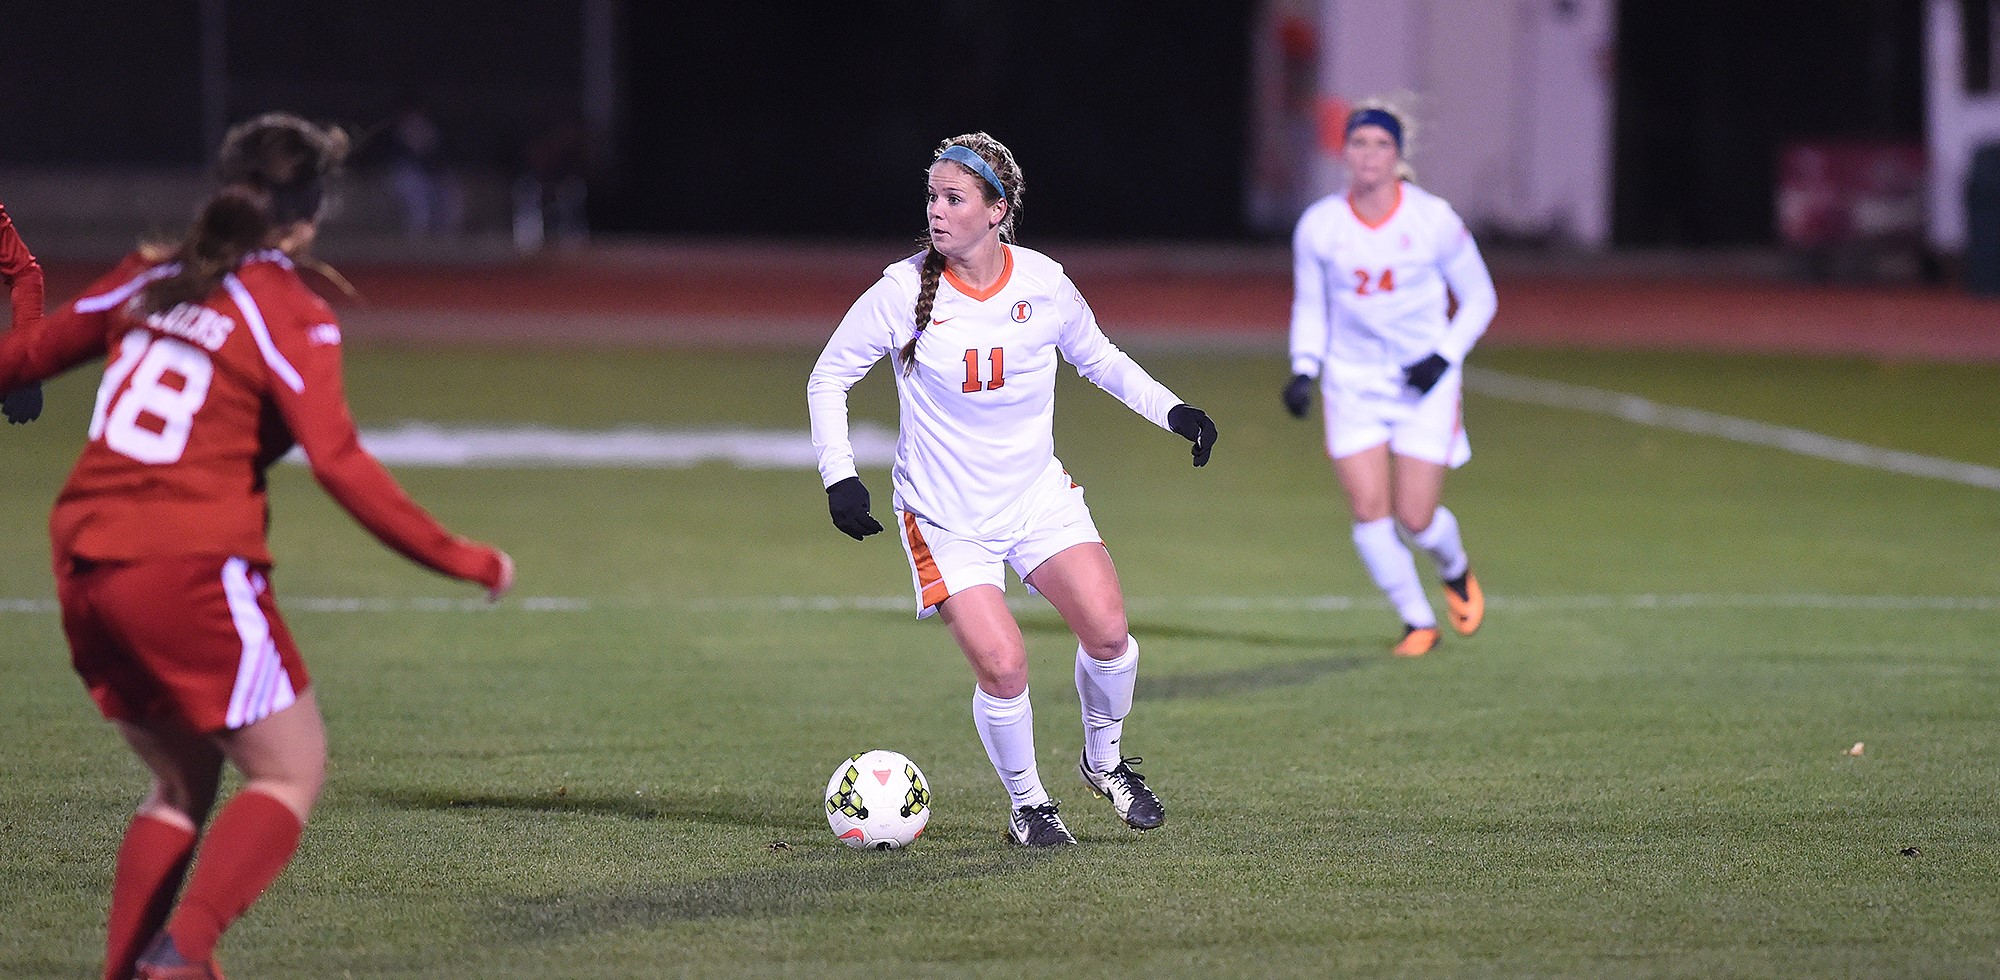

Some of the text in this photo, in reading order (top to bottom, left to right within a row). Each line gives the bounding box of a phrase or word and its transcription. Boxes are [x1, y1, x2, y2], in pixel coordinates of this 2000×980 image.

[1354, 268, 1395, 296] 24
[1016, 303, 1027, 320] I
[962, 346, 1005, 393] 11
[88, 329, 214, 465] 18
